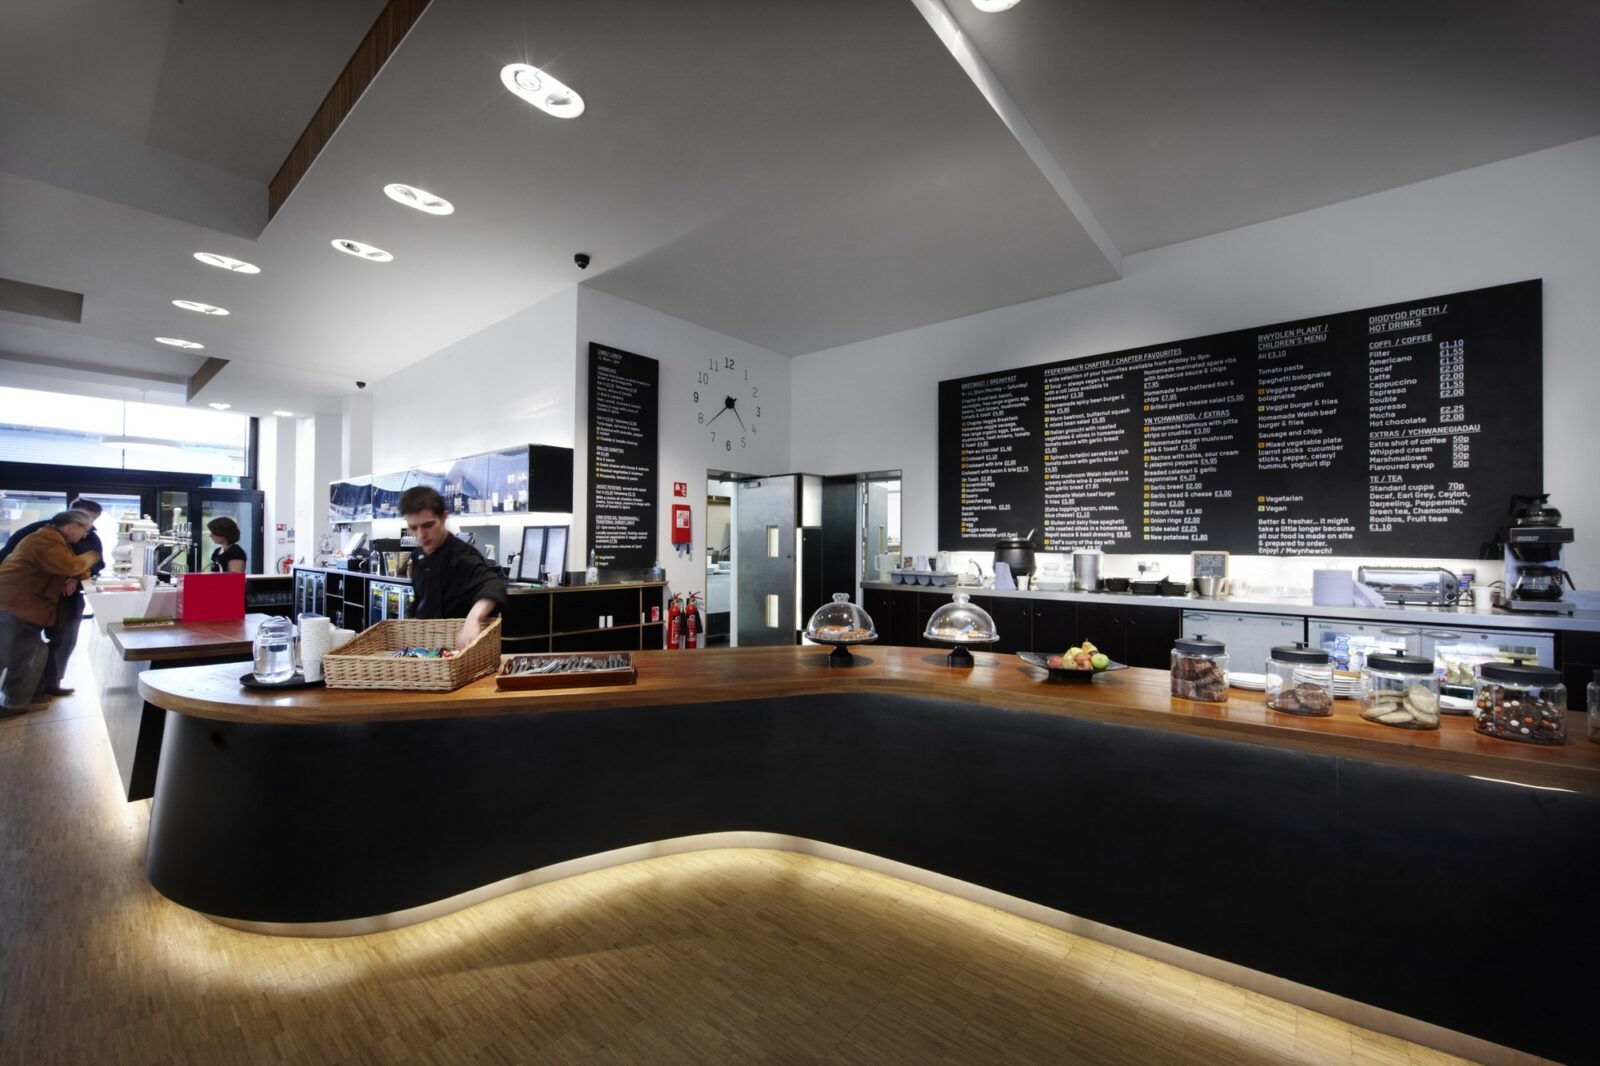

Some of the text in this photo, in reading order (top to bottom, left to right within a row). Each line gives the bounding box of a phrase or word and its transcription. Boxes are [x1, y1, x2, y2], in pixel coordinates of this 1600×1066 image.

[1369, 311, 1408, 324] DIODYDD
[1409, 306, 1440, 318] POETH
[1369, 318, 1422, 333] HOT DRINKS
[1258, 330, 1295, 342] BWYDLEN
[1296, 325, 1322, 337] PLANT
[1304, 333, 1327, 344] MENU
[1401, 334, 1432, 345] COFFEE
[1369, 348, 1464, 366] Americano £1.55
[709, 359, 719, 371] 11
[724, 357, 735, 369] 12
[1369, 356, 1464, 374] Decaf £1.55
[744, 370, 748, 380] 1
[1258, 364, 1304, 375] Tomato pasta
[1369, 364, 1464, 381] Latte £2.00
[698, 372, 708, 384] 10
[1258, 371, 1332, 385] Spaghetti bolognaise
[1369, 372, 1464, 388] Cappuccino £2.00
[753, 387, 758, 398] 2
[1265, 382, 1324, 394] Veggie spaghetti
[1369, 380, 1464, 396] Espresso £1.55
[693, 392, 699, 403] 9
[1258, 393, 1296, 402] bolognaise
[1369, 388, 1464, 404] Double £2.00
[756, 407, 760, 417] 3
[1369, 404, 1407, 412] espresso
[1440, 405, 1465, 415] £2.25
[698, 413, 703, 424] 8
[1204, 410, 1230, 419] EXTRAS
[1258, 413, 1296, 421] Homemade
[1320, 408, 1337, 416] beef
[1385, 417, 1427, 426] chocolate
[1440, 412, 1464, 423] £2.00
[752, 425, 756, 434] 4
[1370, 430, 1400, 439] EXTRAS
[1408, 424, 1480, 436] YCHWANEGIADAU
[710, 432, 716, 442] 7
[741, 437, 746, 448] 5
[1286, 439, 1322, 447] vegetable
[1322, 437, 1342, 445] plate
[1420, 437, 1447, 445] coffee
[1452, 435, 1470, 444] 50p
[726, 440, 731, 451] 6
[1452, 443, 1470, 452] 50p
[1369, 452, 1470, 463] Marshmallows 50p
[1290, 461, 1318, 469] yoghurt
[1411, 462, 1435, 470] syrup
[1452, 459, 1470, 469] 50p
[1369, 484, 1406, 492] Standard
[1448, 482, 1465, 490] 70p
[1369, 492, 1395, 500] Decaf,
[1414, 491, 1436, 499] Grey,
[1438, 490, 1471, 498] Ceylon,
[1369, 498, 1467, 508] Darjeeling, Peppermint,
